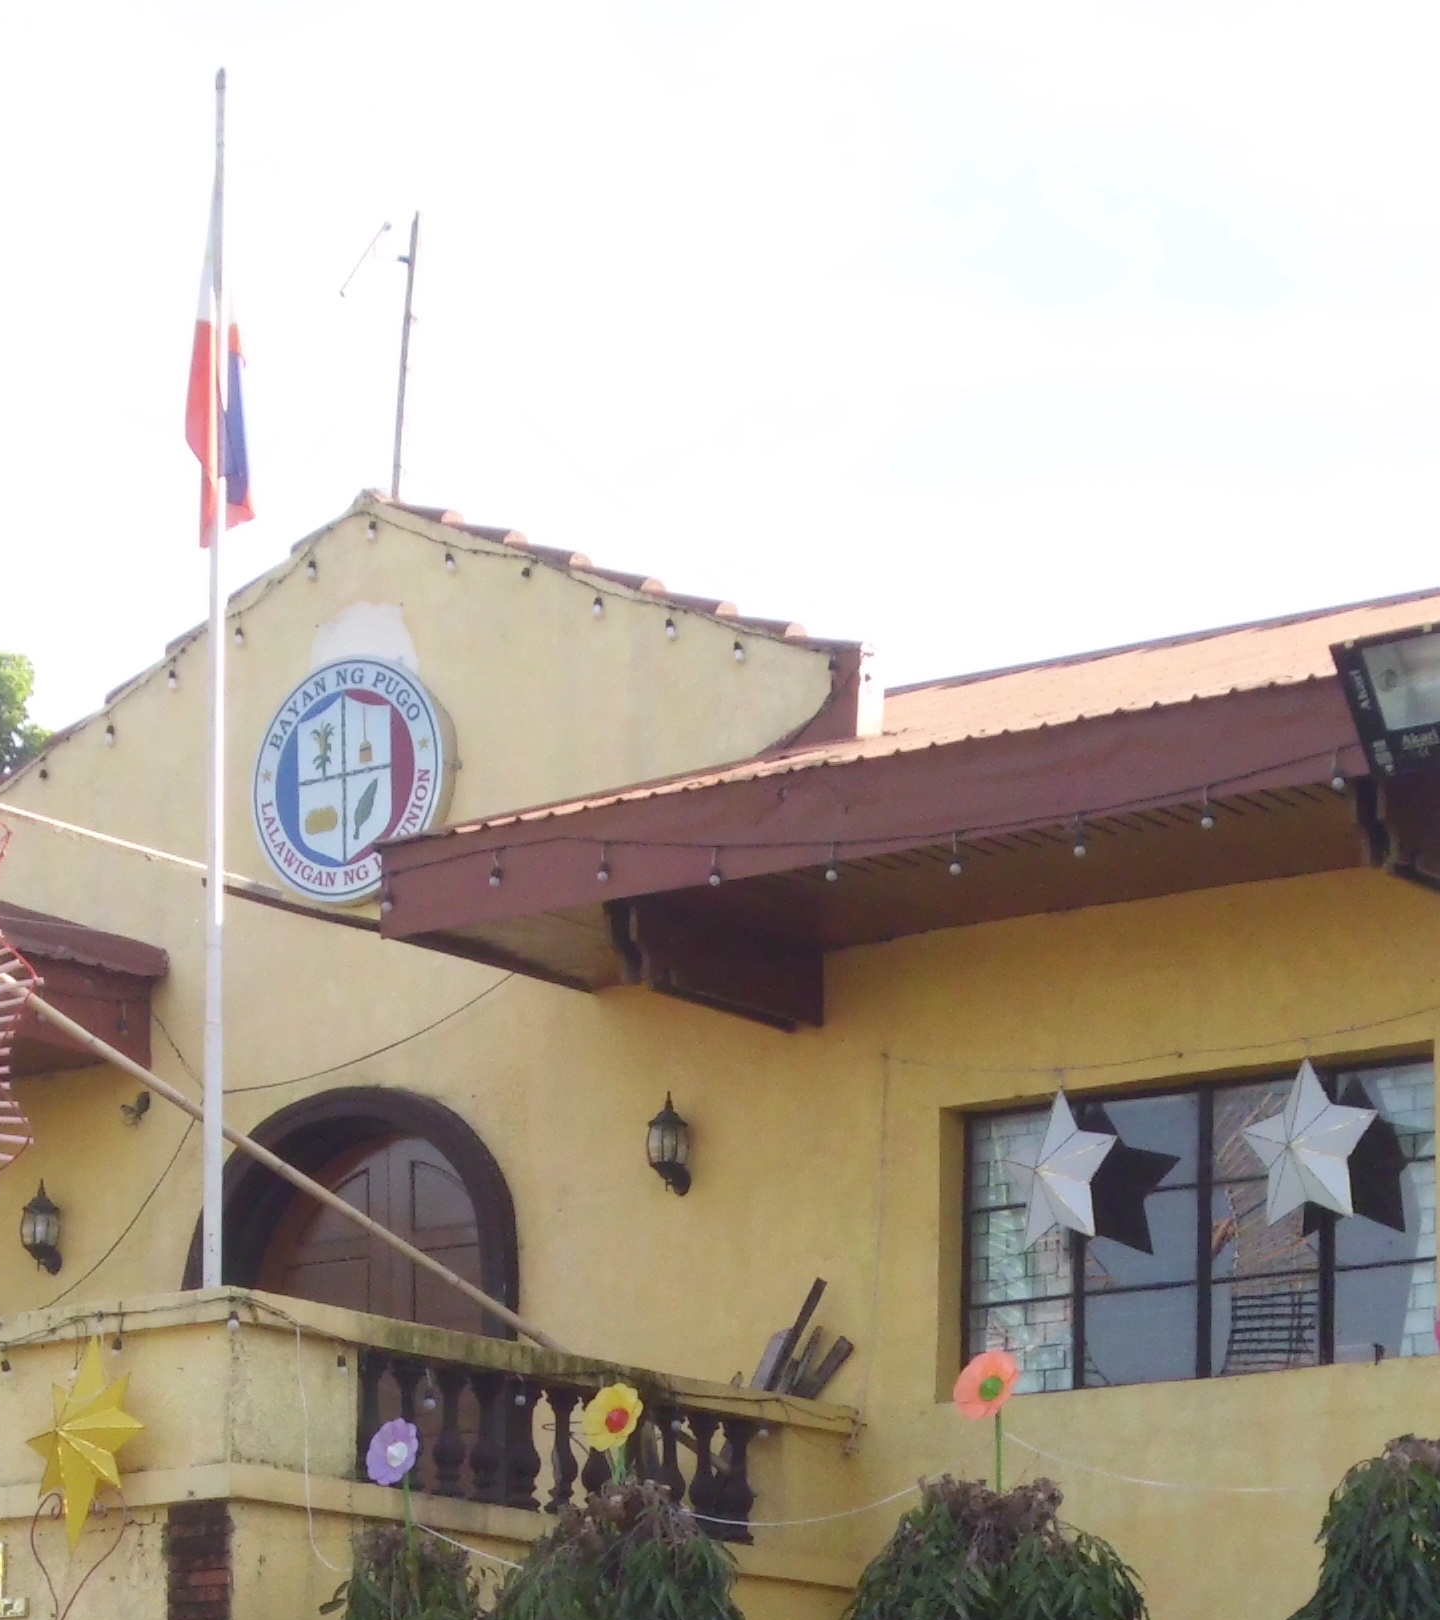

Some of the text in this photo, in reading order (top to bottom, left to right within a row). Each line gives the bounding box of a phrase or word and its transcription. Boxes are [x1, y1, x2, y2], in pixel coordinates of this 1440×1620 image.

[269, 667, 420, 751] BAYAN NG PUGO
[261, 801, 336, 887] LALAWIGAN
[343, 863, 369, 886] NG
